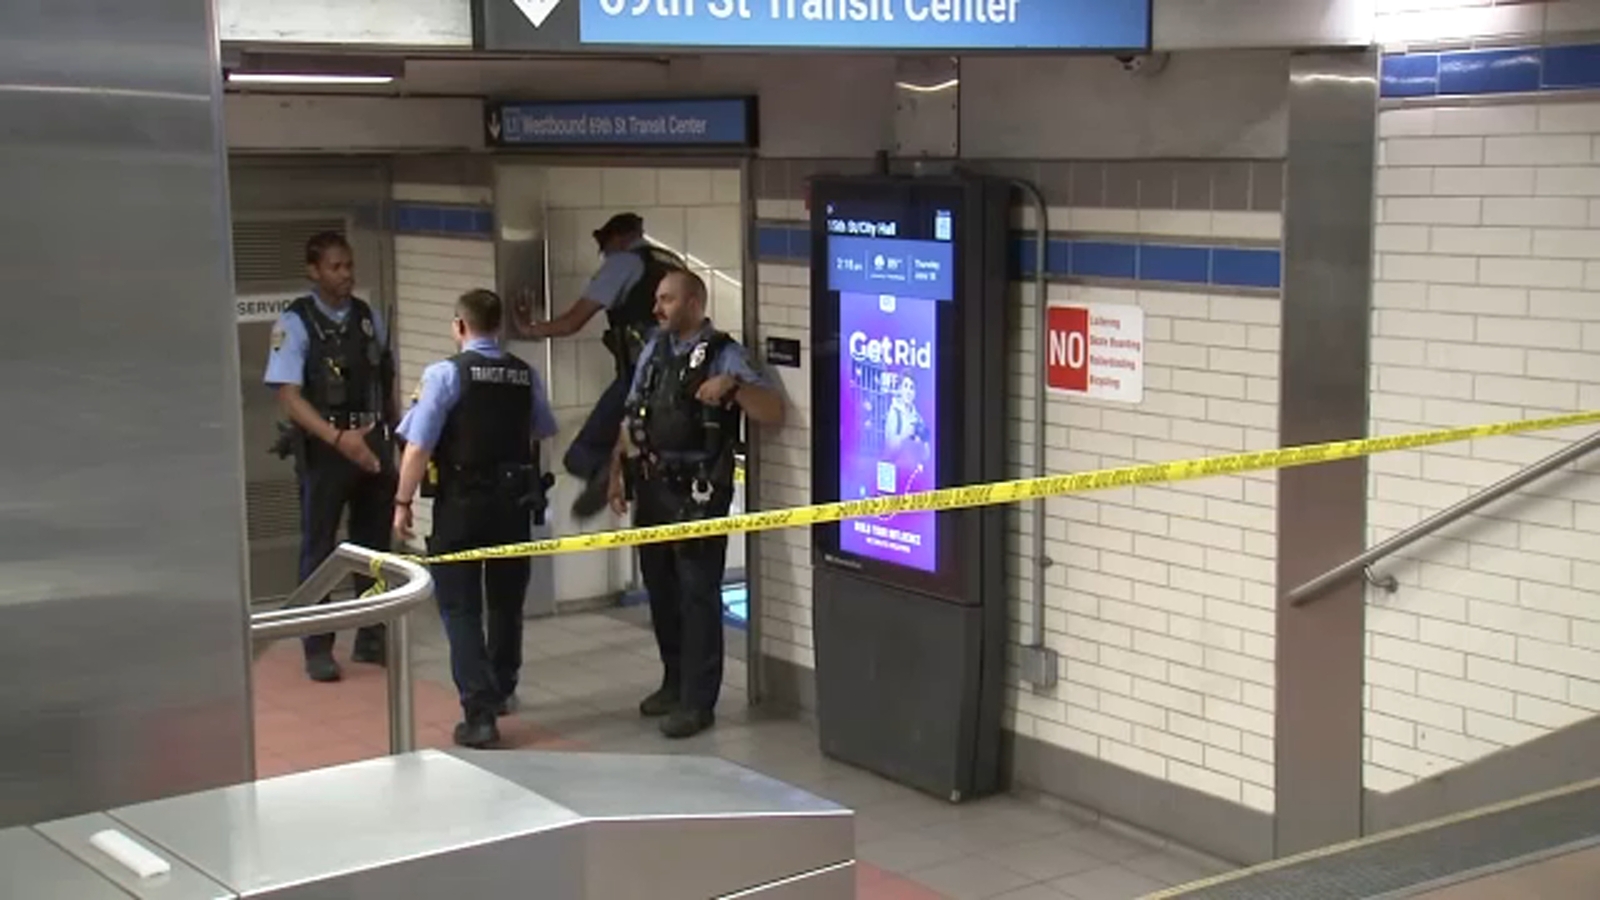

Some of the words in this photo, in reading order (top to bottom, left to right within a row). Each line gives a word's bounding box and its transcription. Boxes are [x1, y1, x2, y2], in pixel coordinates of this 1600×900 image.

[904, 0, 1021, 24] Center
[522, 112, 587, 135] Westbound
[614, 116, 627, 133] St
[629, 116, 666, 134] Transit
[668, 116, 707, 134] Center
[878, 221, 897, 236] Hall
[237, 299, 291, 316] SERVIC
[849, 330, 893, 366] Get
[895, 338, 931, 369] Rid
[1049, 330, 1085, 369] NO
[470, 366, 505, 383] TRANSIT
[506, 369, 531, 386] POLICE
